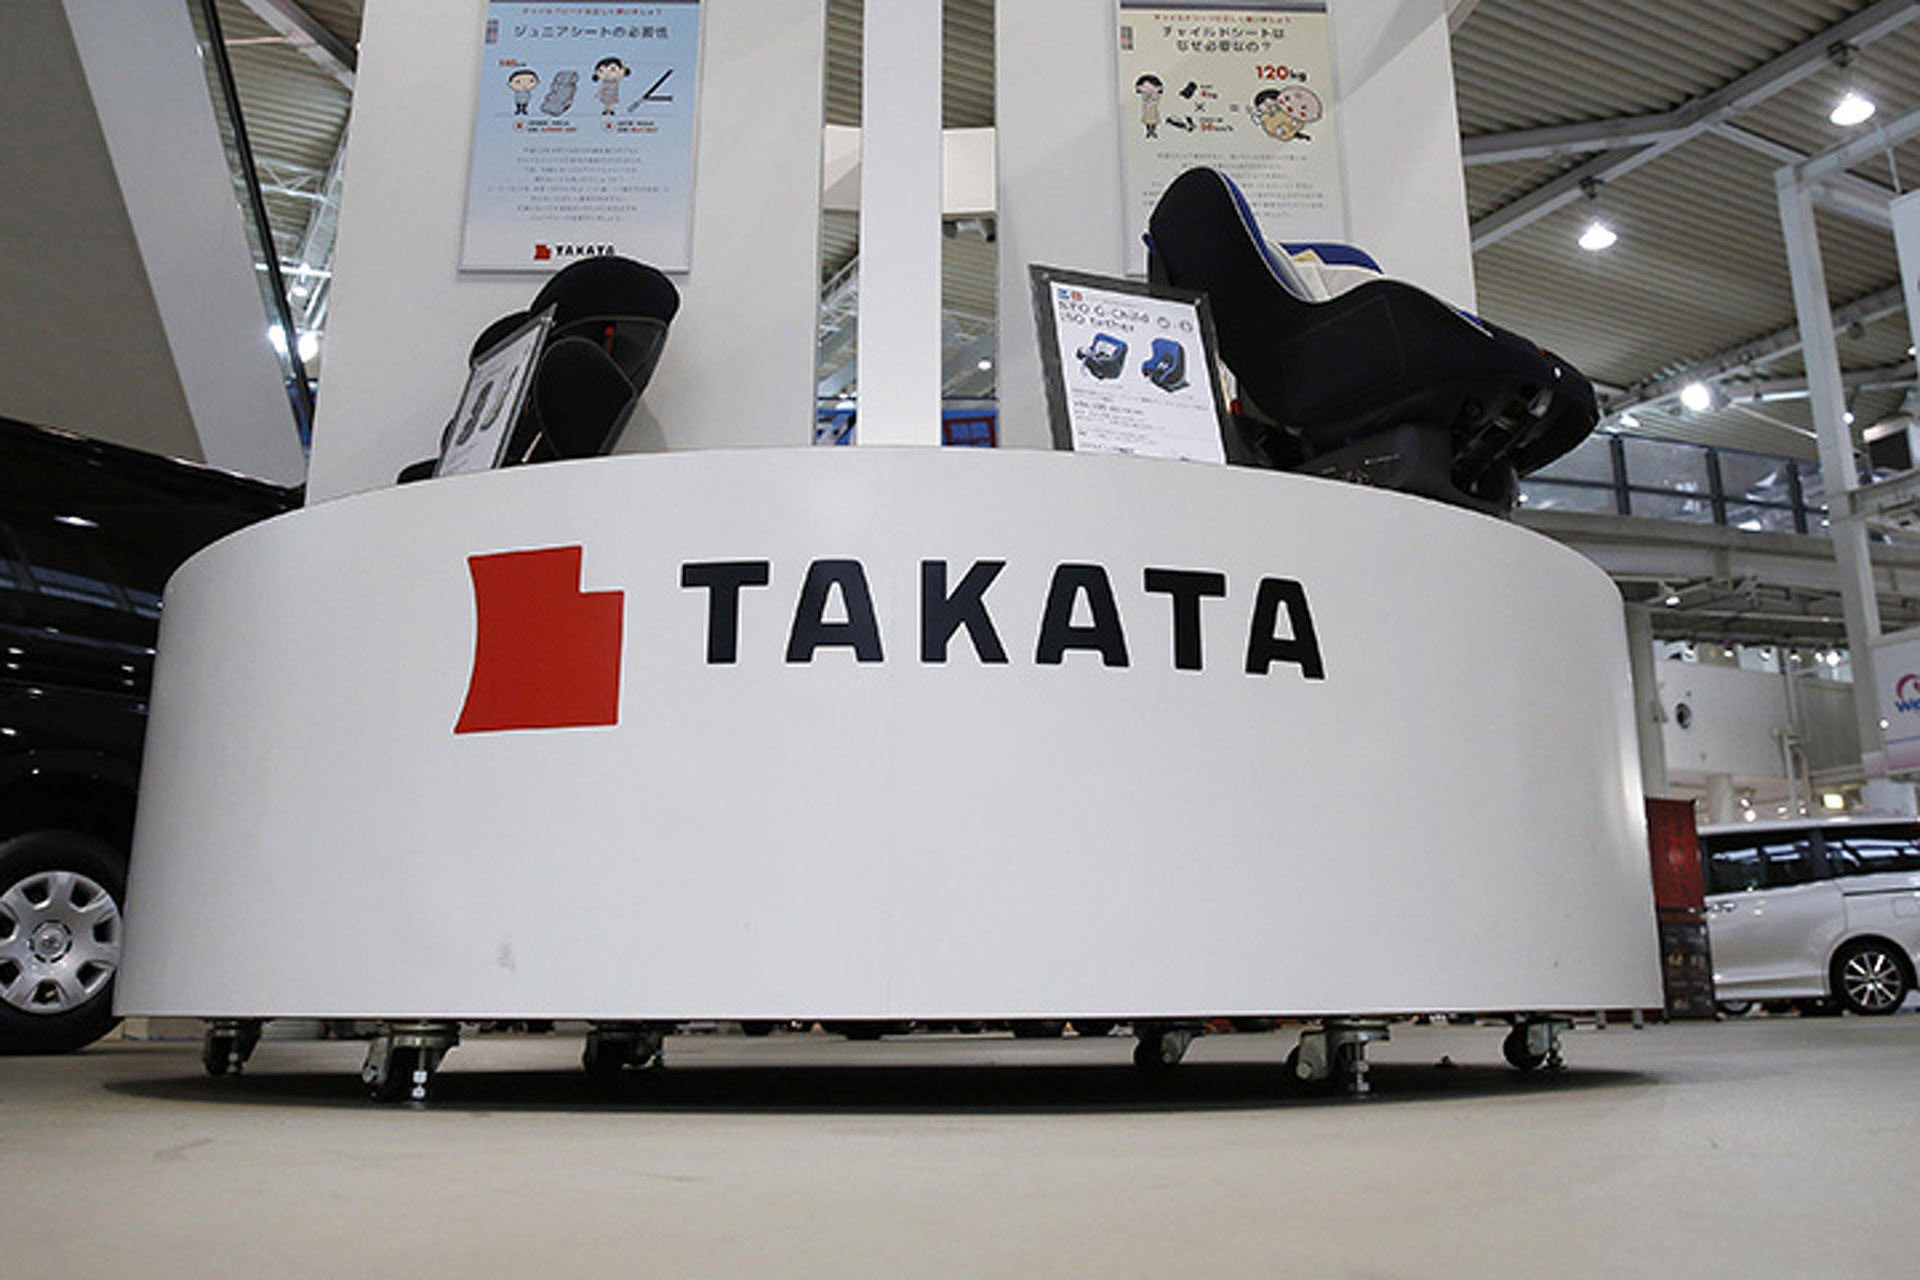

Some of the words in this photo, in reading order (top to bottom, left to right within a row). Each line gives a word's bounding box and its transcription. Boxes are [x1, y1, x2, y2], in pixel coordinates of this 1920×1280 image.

[1163, 26, 1285, 39] チャイルドシートは
[556, 244, 615, 257] TAKATA
[680, 559, 1326, 681] TAKATA
